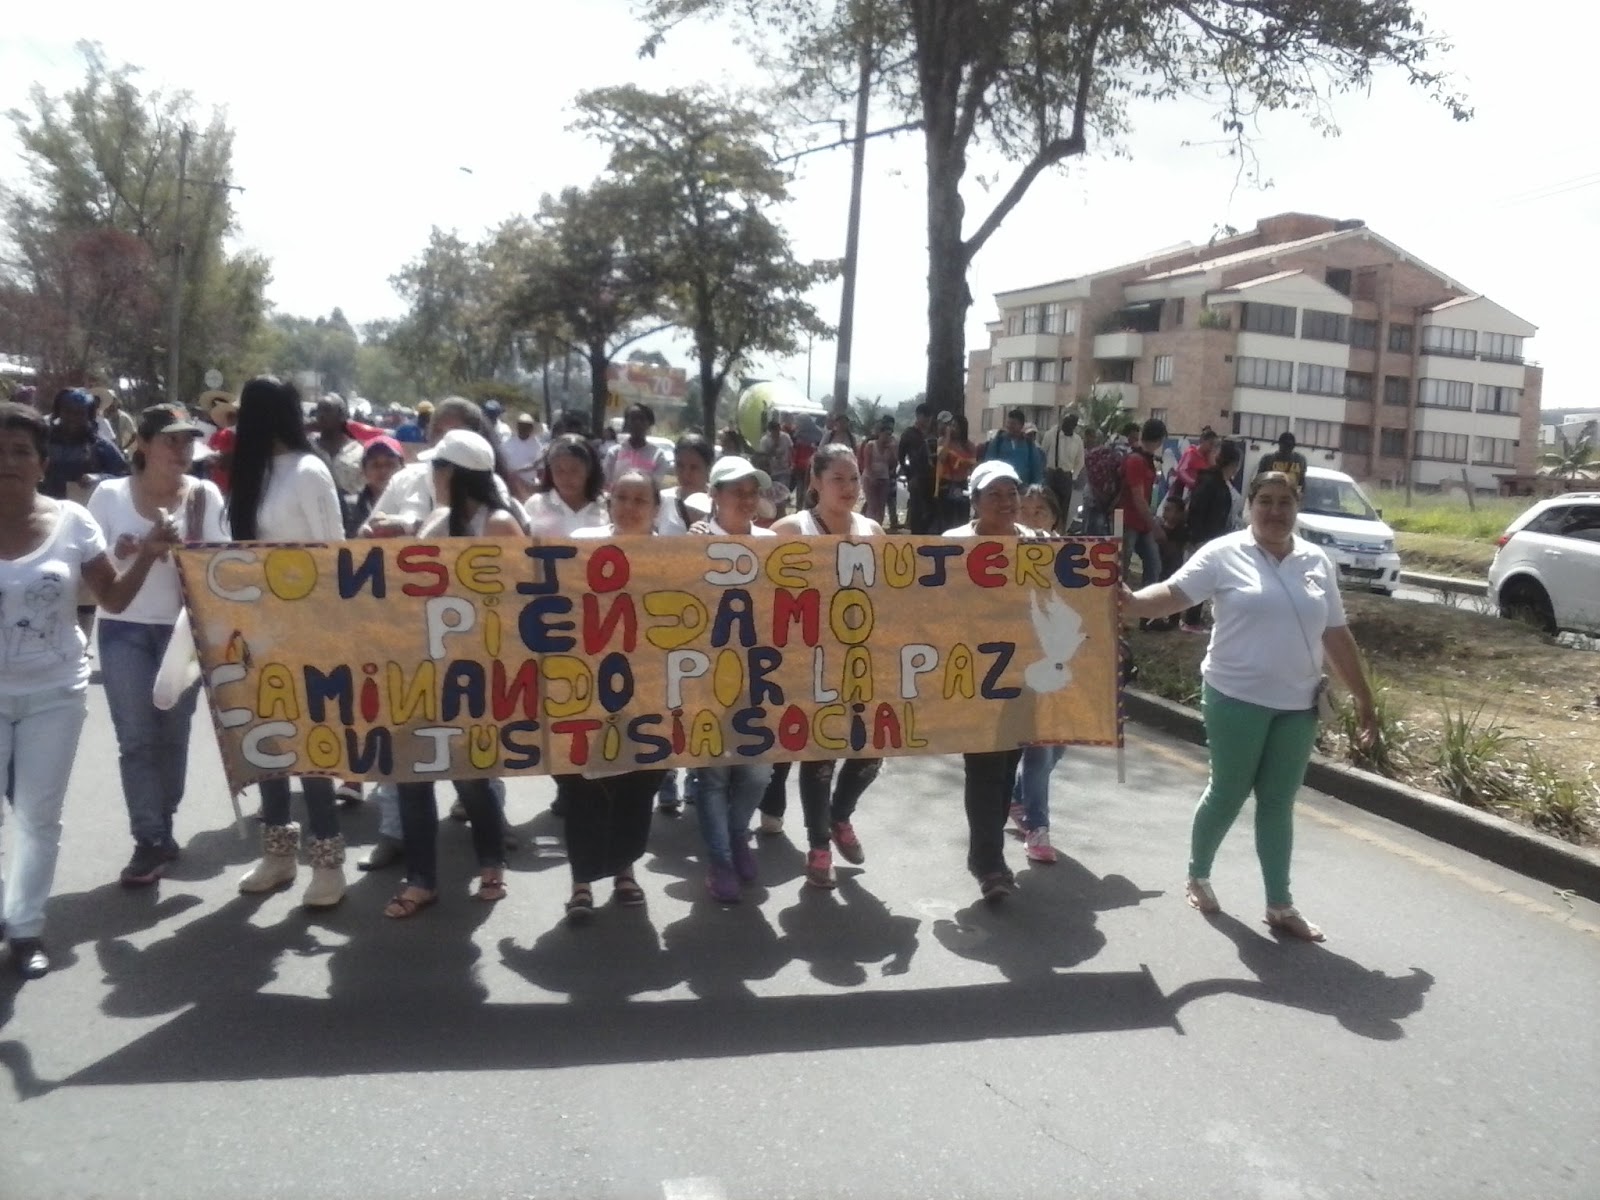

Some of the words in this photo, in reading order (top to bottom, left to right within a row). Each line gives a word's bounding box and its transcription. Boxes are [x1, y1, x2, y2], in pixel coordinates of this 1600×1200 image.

[206, 544, 630, 601] CONSEJO
[704, 541, 812, 587] DE
[837, 541, 1120, 588] MUJERES
[666, 645, 784, 709] POR
[813, 644, 874, 703] LA
[900, 641, 1021, 699] PAZ
[241, 720, 393, 775] CON
